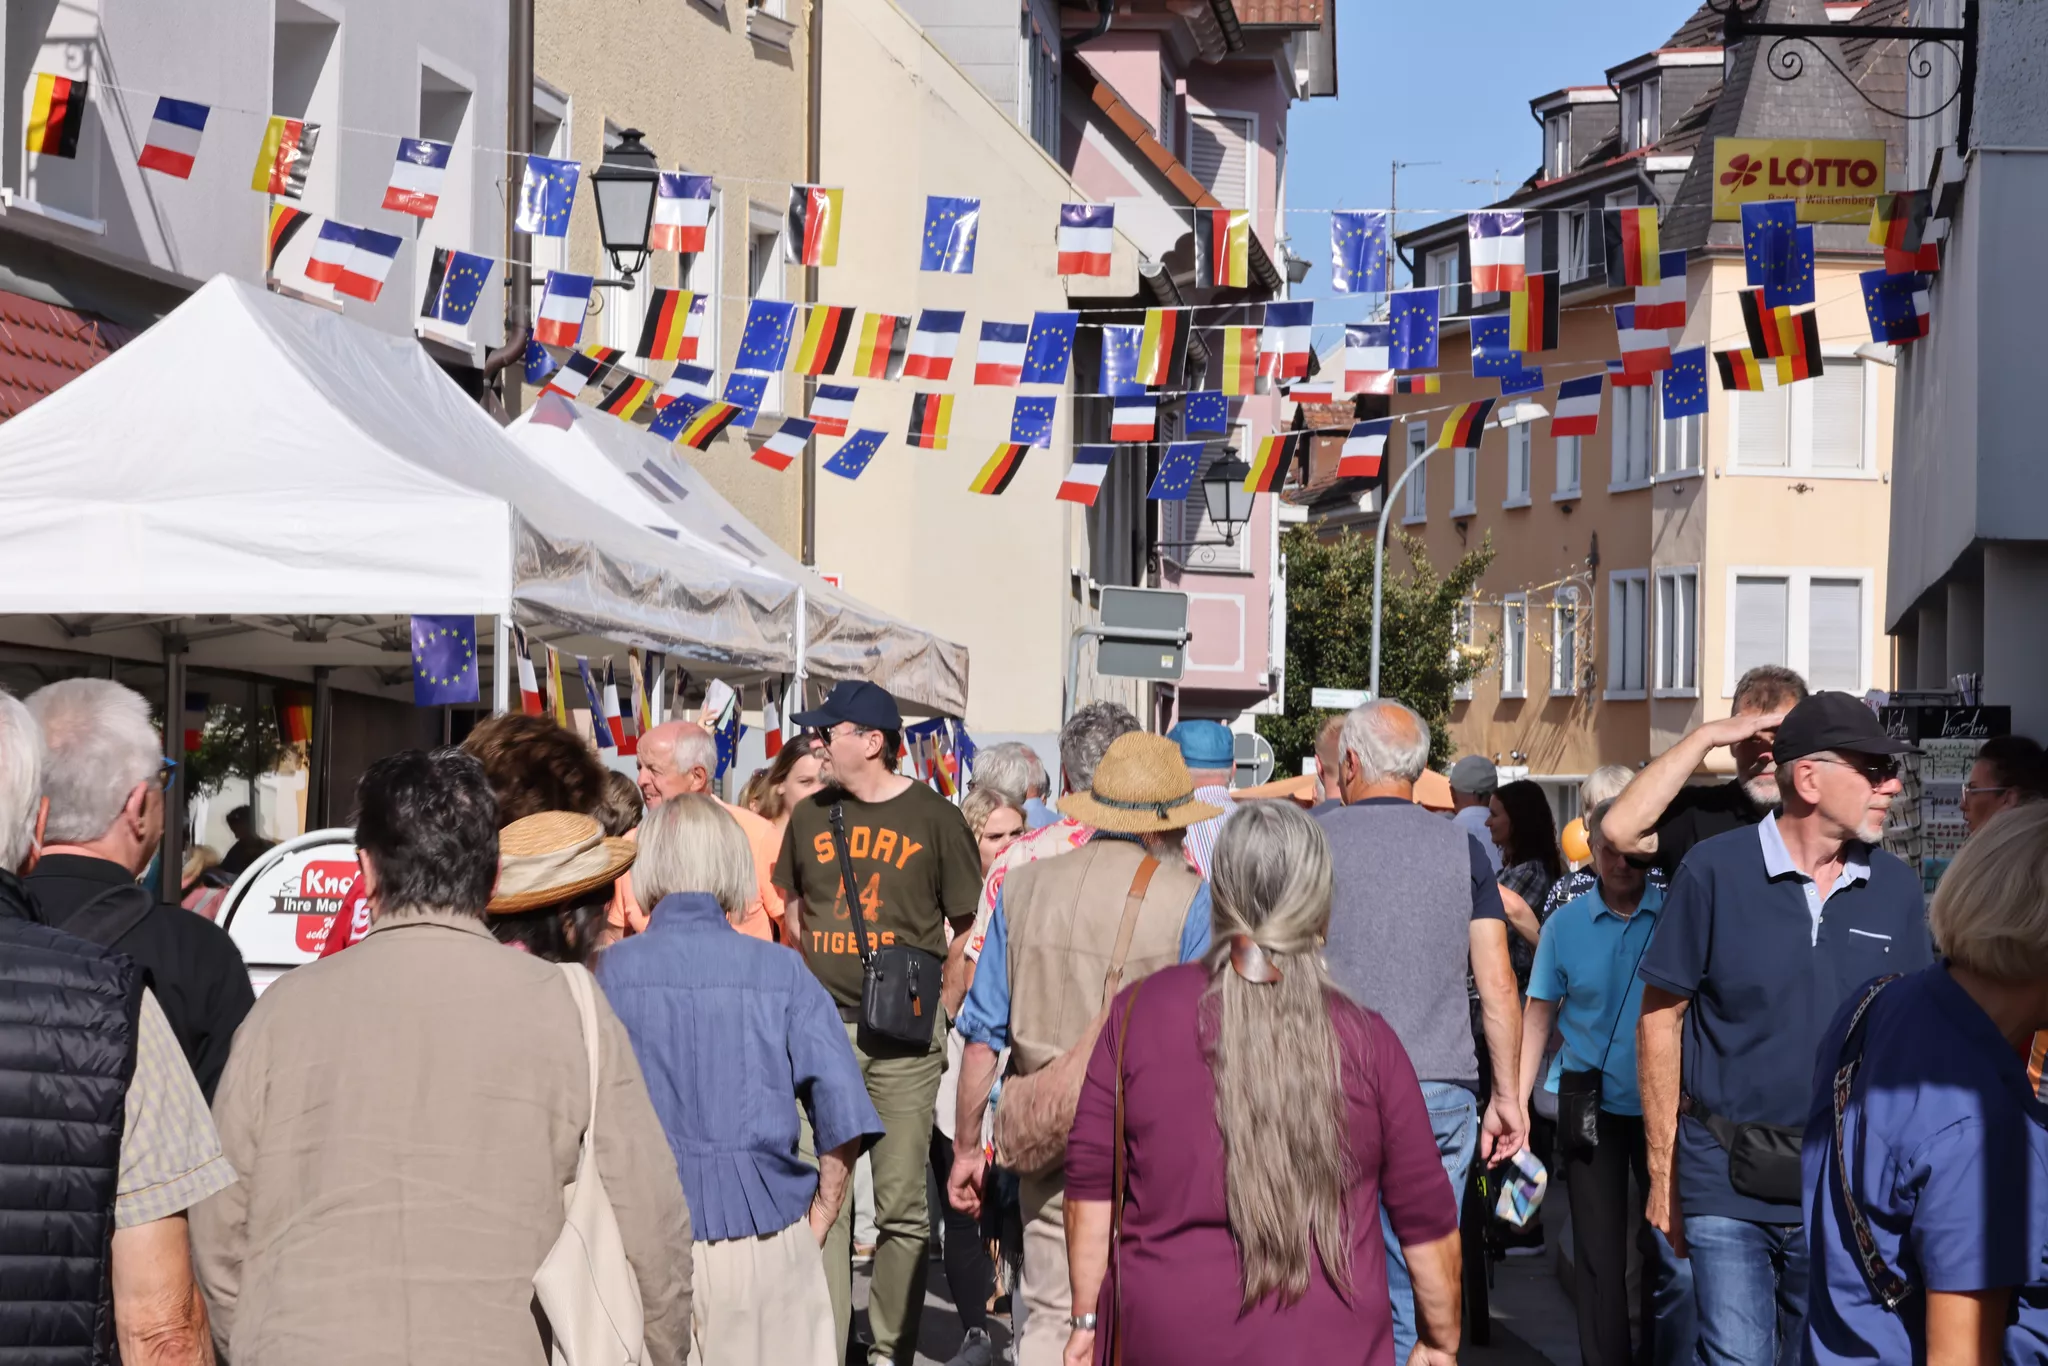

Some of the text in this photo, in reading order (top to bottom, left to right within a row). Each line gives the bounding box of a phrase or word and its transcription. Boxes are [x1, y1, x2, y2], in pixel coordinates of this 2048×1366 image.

[1769, 157, 1877, 187] LOTTO
[813, 826, 923, 870] SDRY
[306, 869, 361, 895] Kno
[283, 898, 311, 912] Ihre
[812, 931, 895, 954] TIGERS
